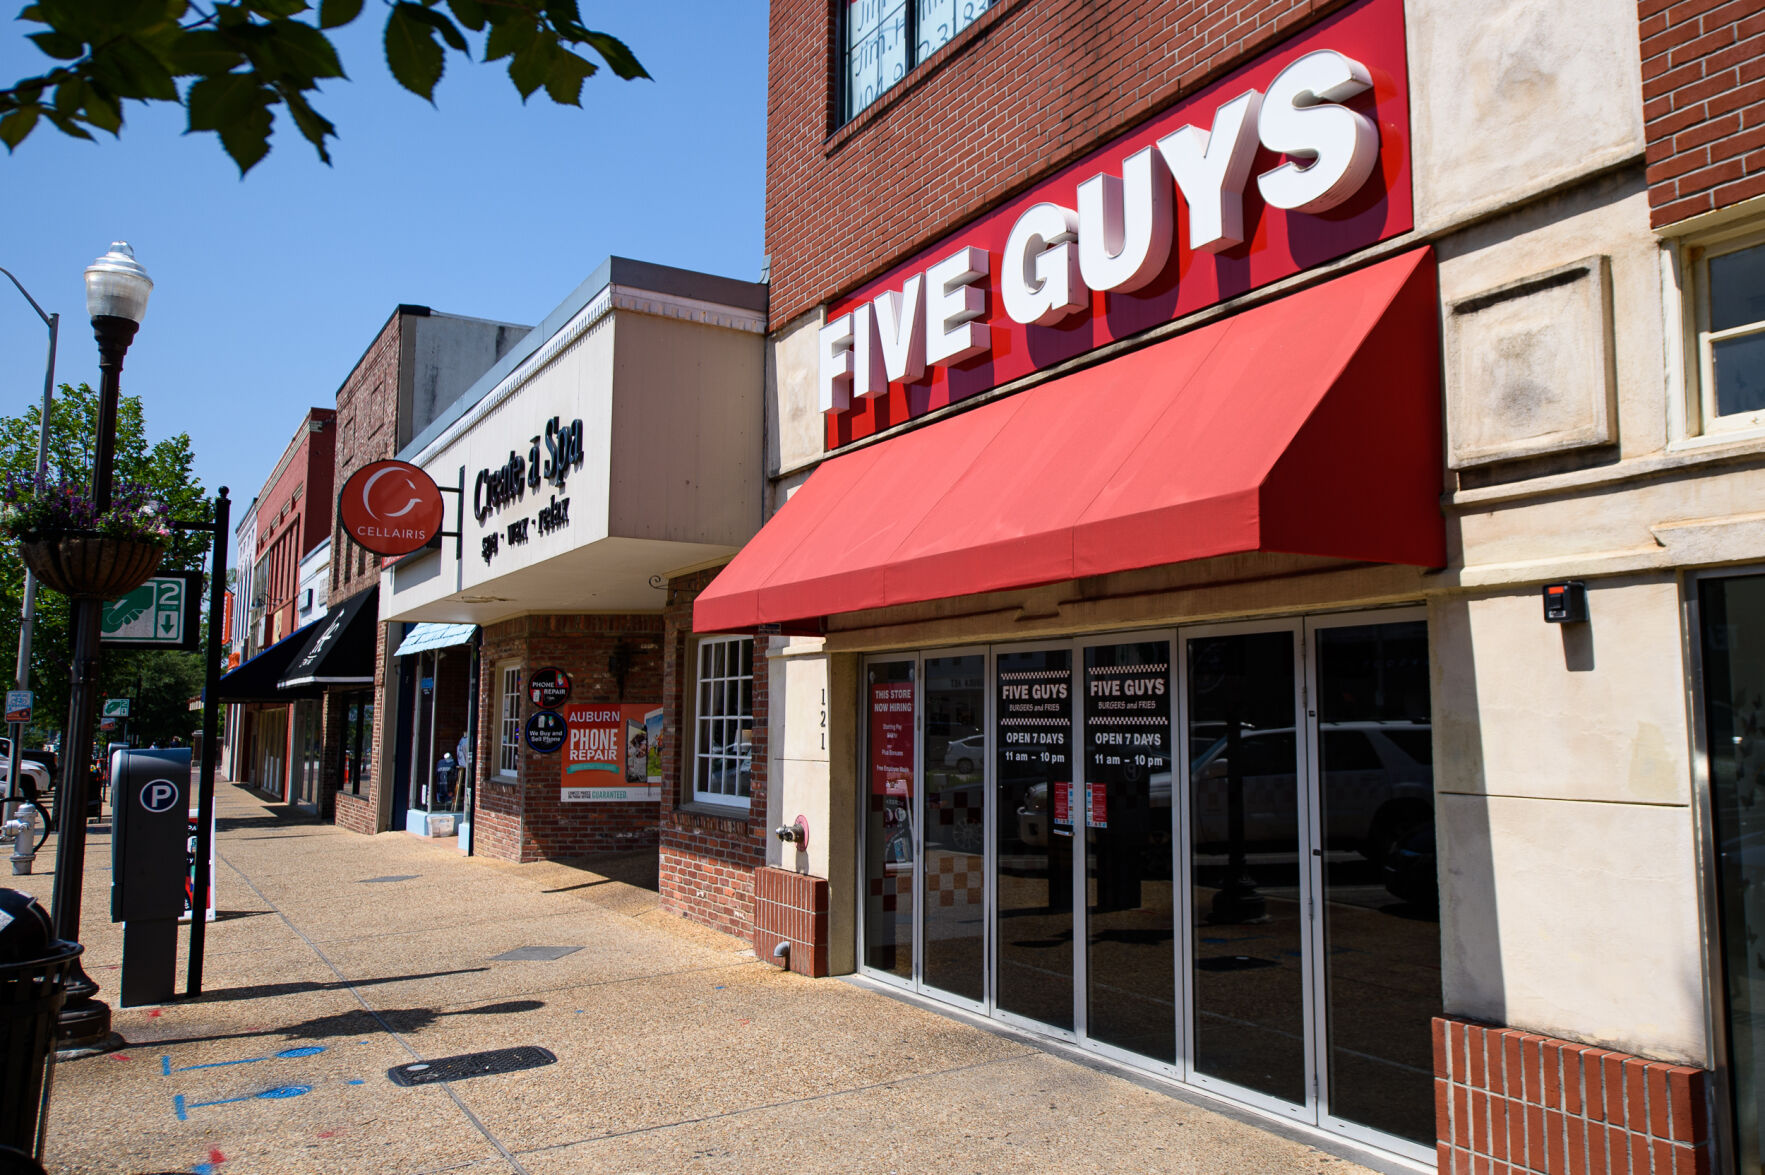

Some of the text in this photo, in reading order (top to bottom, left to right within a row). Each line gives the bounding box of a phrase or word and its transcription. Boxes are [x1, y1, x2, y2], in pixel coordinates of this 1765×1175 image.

[819, 49, 1379, 415] FIVE GUYS
[474, 450, 525, 522] Create
[544, 416, 584, 488] Spa
[357, 526, 426, 540] CELLAIRIS
[482, 495, 570, 566] spa wax relax
[159, 583, 179, 605] 2
[1002, 684, 1068, 700] FIVE GUYS
[1090, 678, 1165, 696] FIVE GUYS
[875, 689, 911, 699] THIS STORE
[874, 703, 912, 712] NOW HIRING
[1098, 701, 1156, 709] BURGERS and FRIES
[569, 711, 620, 722] AUBURN
[570, 729, 618, 750] PHONE
[1006, 733, 1064, 744] OPEN 7 DAYS
[1095, 733, 1161, 746] OPEN 7 DAYS
[569, 750, 617, 760] REPAIR
[1005, 752, 1014, 761] 11
[1015, 753, 1028, 761] am
[1040, 752, 1050, 762] 10
[1051, 753, 1065, 764] pm
[1095, 754, 1104, 764] 11
[1106, 756, 1120, 765] am
[1134, 755, 1146, 766] 10
[1147, 757, 1163, 767] pm
[152, 785, 172, 808] P
[592, 791, 627, 799] GUARANTEED
